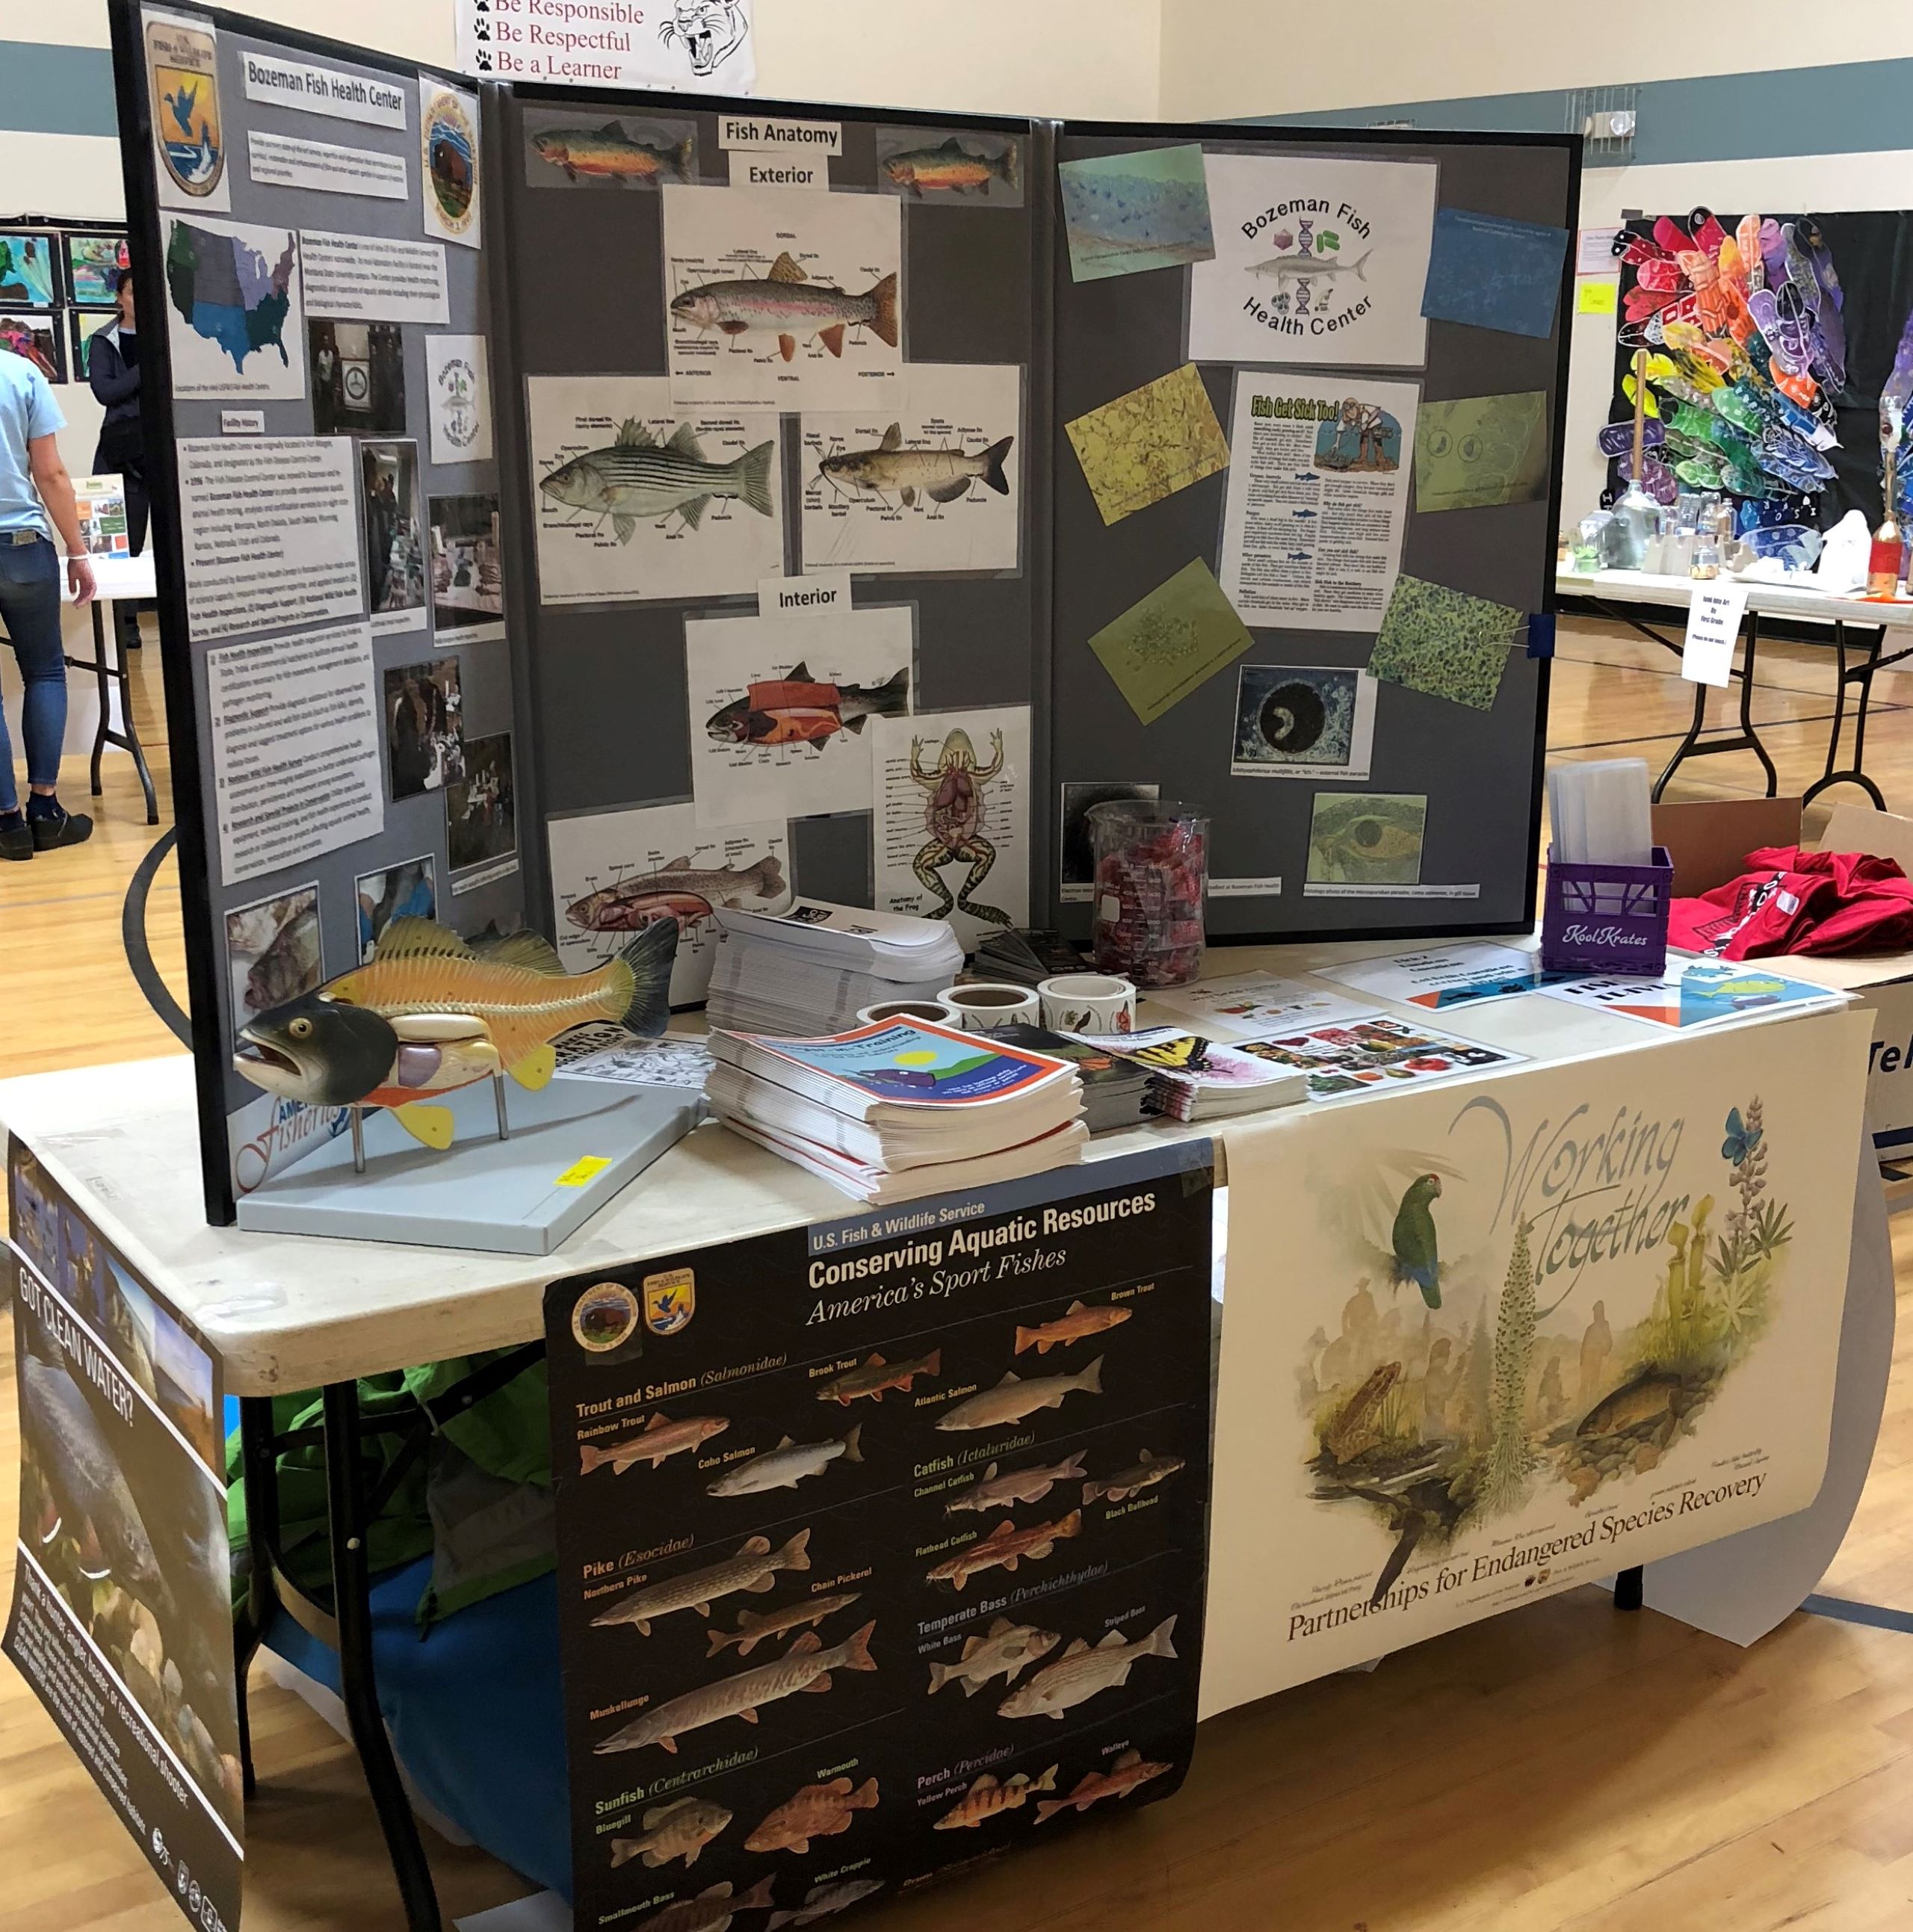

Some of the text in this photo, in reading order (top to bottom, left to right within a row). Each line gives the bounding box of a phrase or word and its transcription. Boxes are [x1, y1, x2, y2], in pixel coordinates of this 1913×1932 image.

[495, 0, 644, 24] Be Responsible
[495, 22, 631, 52] Be Respectful
[498, 52, 622, 79] Be a Learner
[248, 61, 402, 111] Bozeman Fish Health Center
[726, 123, 837, 147] Fish Anatomy
[750, 167, 813, 183] Exterior
[1241, 199, 1372, 240] Bozeman Fish
[1243, 295, 1371, 335] Health Center
[1251, 395, 1340, 422] Fish Get Sick Too!
[779, 587, 837, 608] Interior
[889, 896, 915, 904] Anatomy
[905, 903, 918, 911] Frog
[1447, 1095, 1686, 1236] Working
[814, 1201, 985, 1251] U.S. Fish & Wildlife Service
[809, 1192, 1156, 1289] Conserving Aquatic Resources
[1527, 1184, 1690, 1322] Together
[805, 1247, 1066, 1325] America's Sport Fishes
[1111, 1282, 1155, 1301] Brown Trout
[19, 1266, 134, 1428] GOT CLEAN WATER?
[809, 1357, 857, 1378] Brook Trout
[576, 1352, 788, 1417] Trout and Salmon (Salmonidae)
[915, 1384, 977, 1408] Atlantic Salmon
[577, 1414, 645, 1440] Rainbow Trout
[698, 1446, 755, 1470] Coho Salmon
[915, 1456, 954, 1477] Catfish
[915, 1471, 974, 1497] Channel Catfish
[1106, 1494, 1159, 1520] Black Bullhead
[583, 1534, 694, 1579] Pike (Esocidae)
[915, 1530, 977, 1557] Flathead Catfish
[1288, 1568, 1429, 1642] Partnerships
[1435, 1567, 1468, 1593] for
[1471, 1517, 1596, 1583] Endangered
[1599, 1498, 1675, 1544] Species
[1679, 1470, 1767, 1517] Recovery
[584, 1573, 647, 1600] Northern Pike
[811, 1567, 872, 1593] Chain Pickerel
[918, 1606, 977, 1635] Temperate
[980, 1596, 1007, 1614] Bass
[1104, 1605, 1146, 1628] Striped Bass
[918, 1633, 962, 1654] White Bass
[590, 1694, 649, 1720] Muskellunge
[110, 1692, 119, 1709] or
[118, 1701, 160, 1771] recreational
[160, 1759, 188, 1810] shooter.
[1101, 1739, 1129, 1756] Walleye
[817, 1757, 859, 1780] Warmouth
[917, 1743, 1015, 1789] Perch (Percidae)
[595, 1746, 758, 1815] Sunfish (Centrarchidae)
[917, 1782, 967, 1806] Yellow Perch
[596, 1814, 631, 1834] Bluegill
[815, 1868, 838, 1883] White
[599, 1890, 675, 1925] Smallmouth Bass
